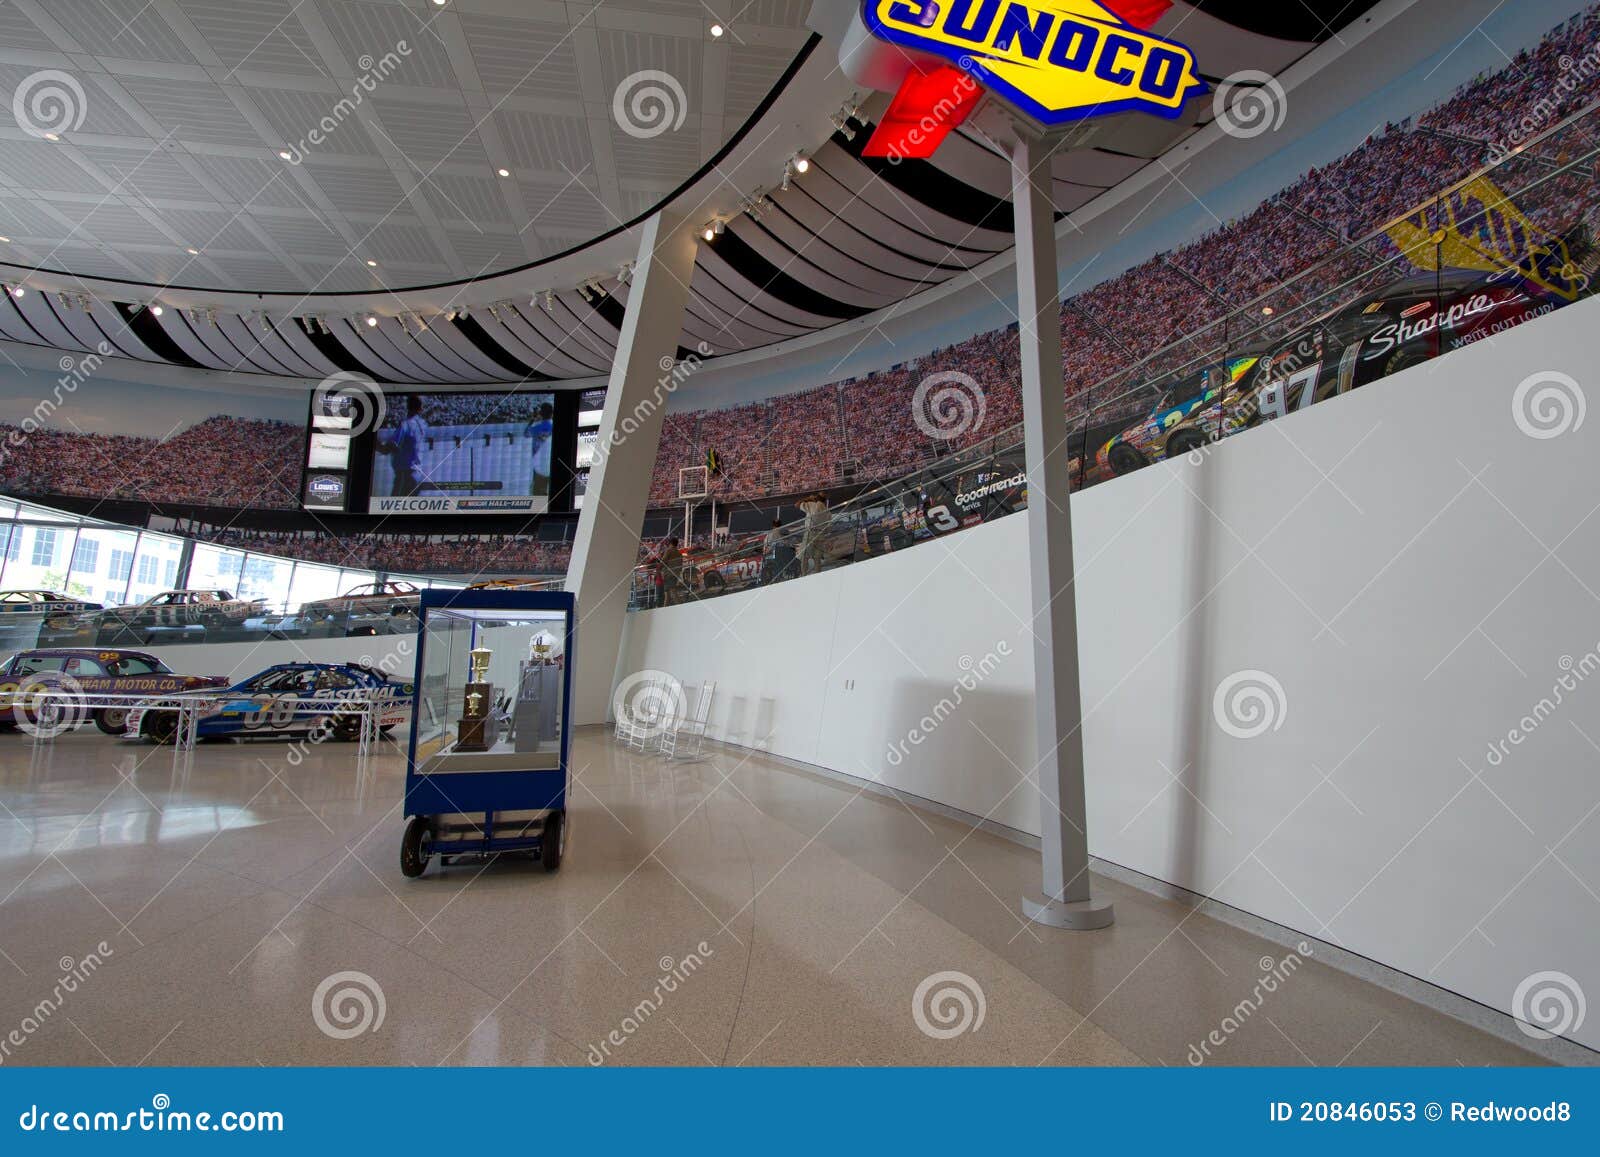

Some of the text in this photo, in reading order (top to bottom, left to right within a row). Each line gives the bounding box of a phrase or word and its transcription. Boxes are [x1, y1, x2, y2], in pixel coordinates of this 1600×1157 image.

[888, 0, 1186, 100] SUNOCO
[1363, 294, 1497, 361] Sharpie
[1451, 328, 1489, 349] WRITE
[1492, 317, 1518, 335] OUT
[1258, 360, 1323, 421] 97
[955, 472, 1028, 506] Goodwrench
[380, 500, 450, 511] WELCOME
[927, 505, 959, 531] 3
[31, 603, 86, 611] BUSCH
[99, 652, 120, 661] 99
[114, 679, 157, 690] MOTOR
[160, 680, 177, 690] CO.
